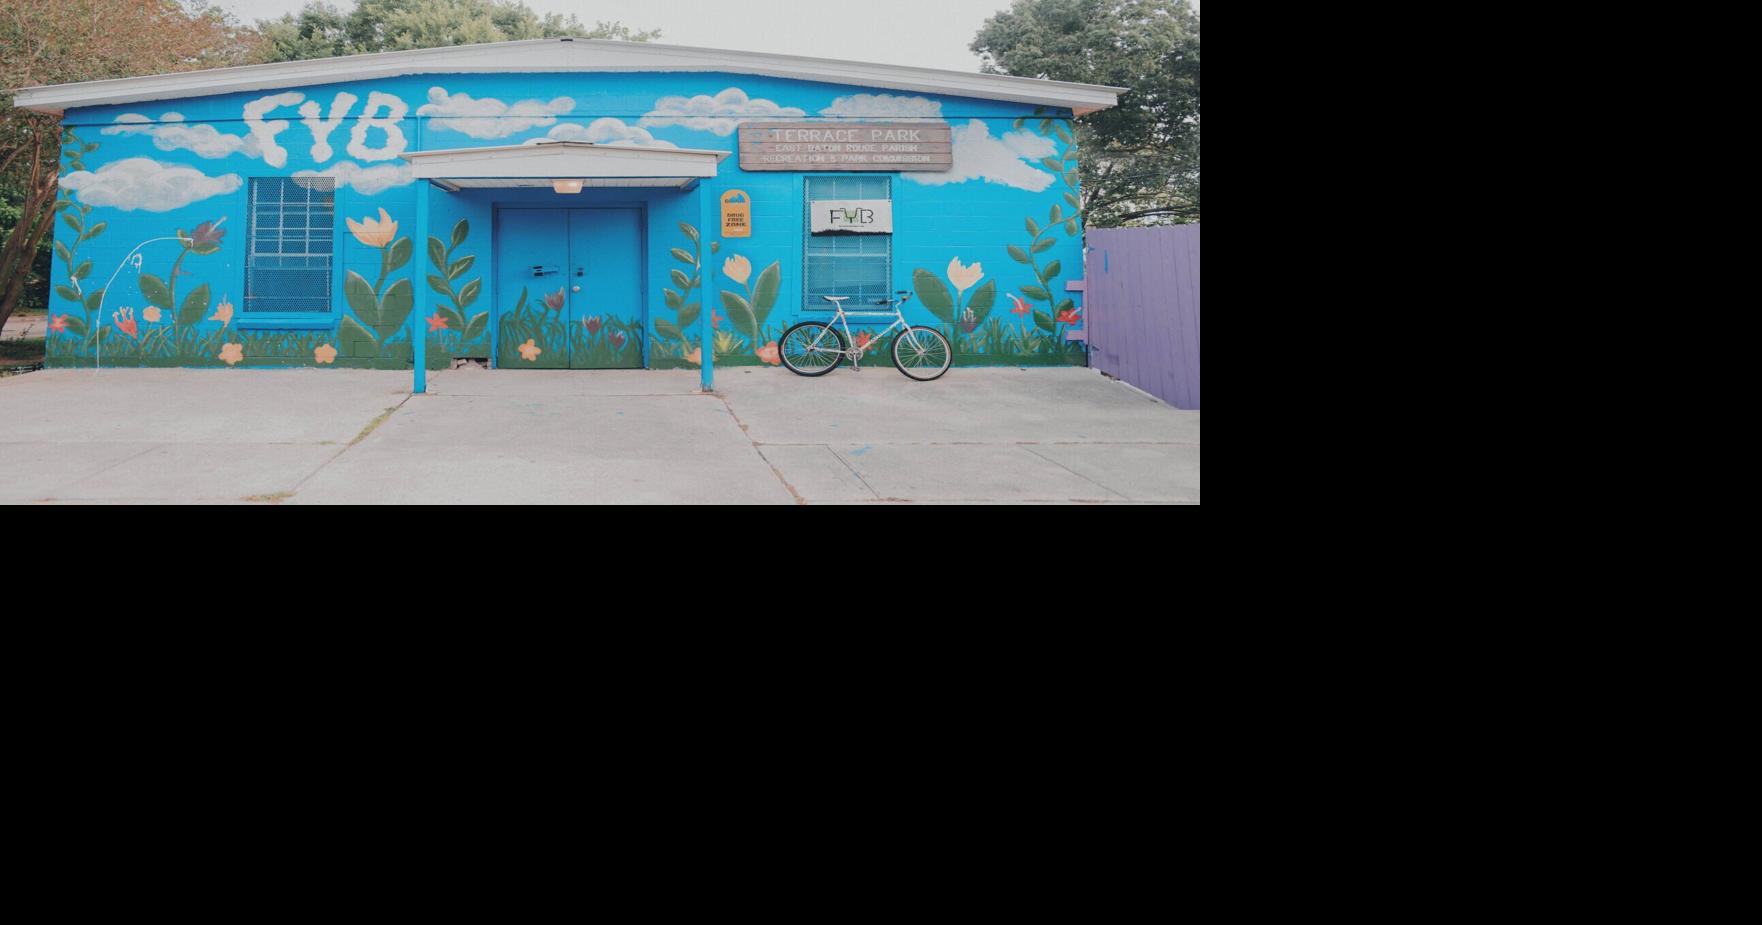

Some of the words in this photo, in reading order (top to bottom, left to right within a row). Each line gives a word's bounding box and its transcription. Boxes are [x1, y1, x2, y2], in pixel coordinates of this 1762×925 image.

[243, 91, 408, 168] FYB
[773, 128, 859, 143] TERRACE
[871, 128, 921, 143] PARK
[775, 144, 800, 153] EAST
[807, 144, 841, 153] BATON
[846, 144, 877, 153] ROUGE
[881, 144, 918, 153] PARISH
[762, 154, 825, 163] RECREATION
[841, 154, 868, 163] PARK
[872, 154, 930, 163] COMMISSION
[829, 207, 874, 224] FYB
